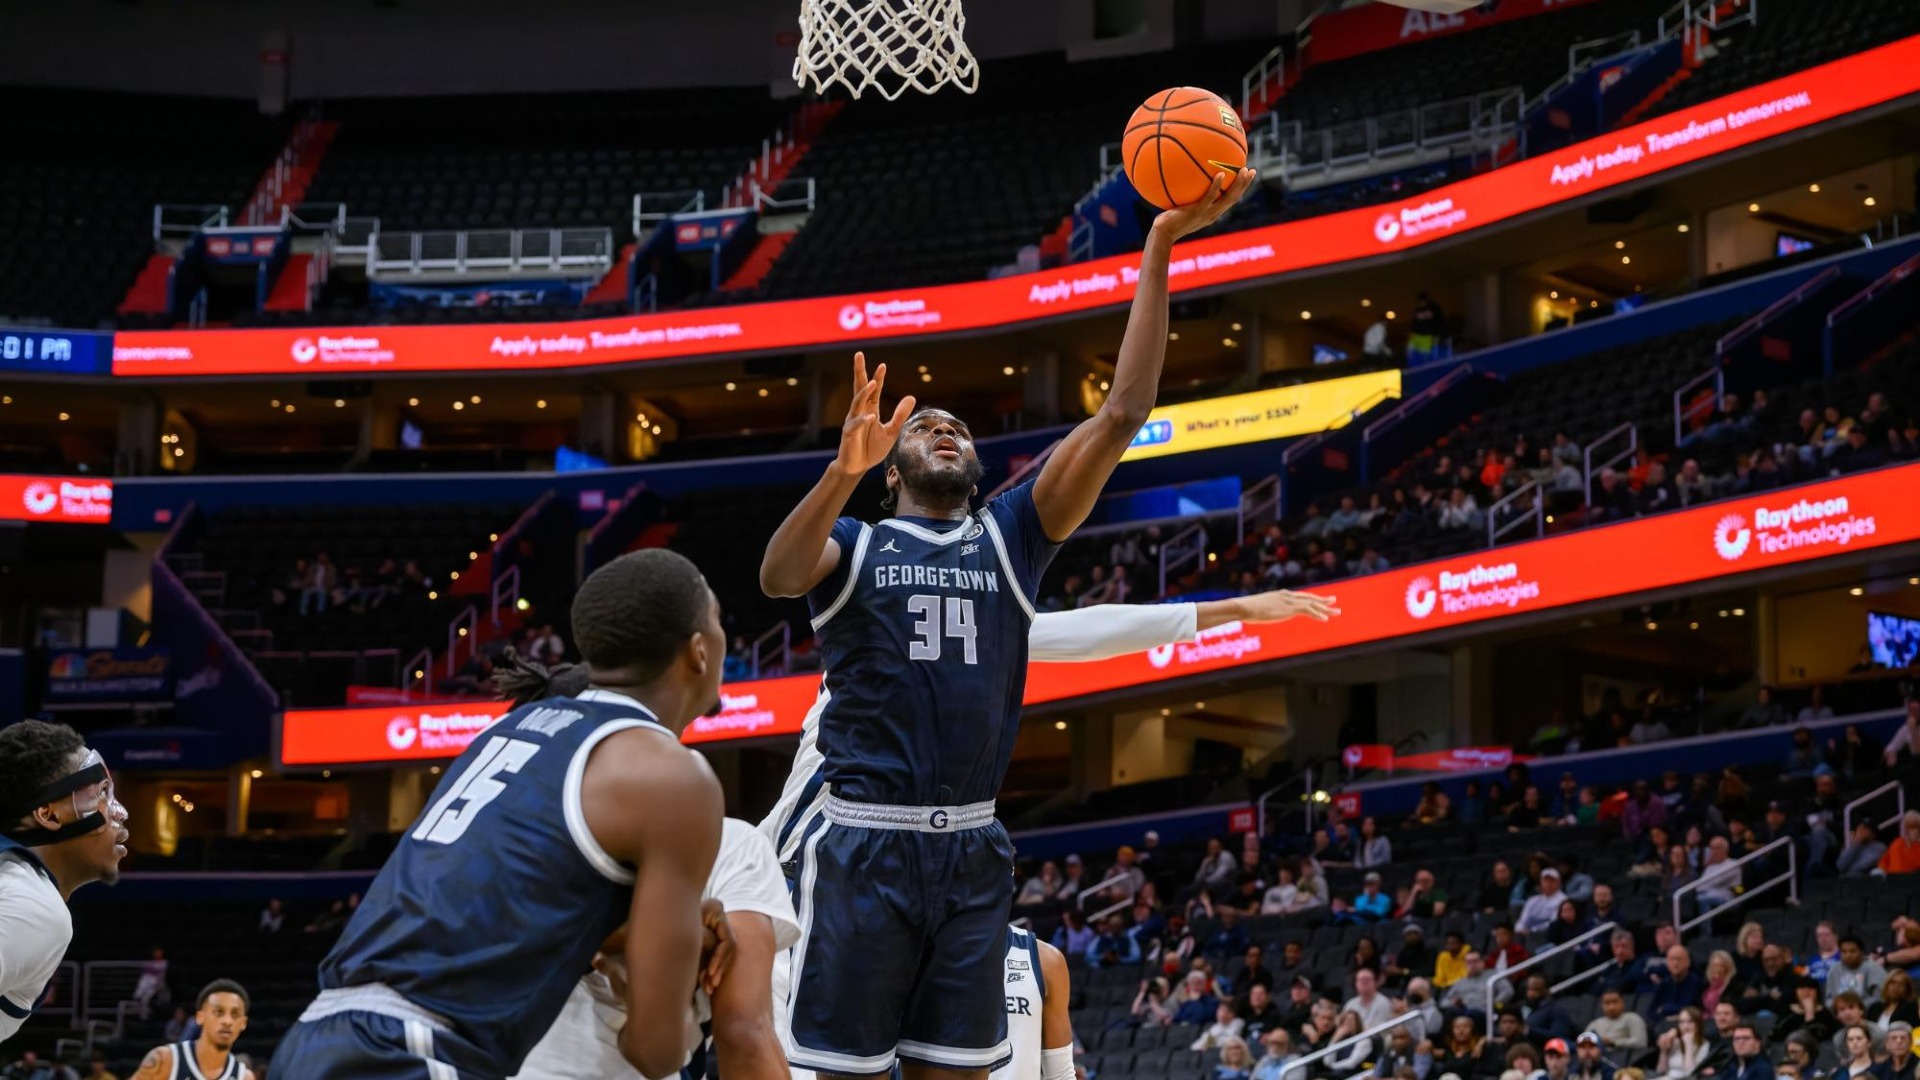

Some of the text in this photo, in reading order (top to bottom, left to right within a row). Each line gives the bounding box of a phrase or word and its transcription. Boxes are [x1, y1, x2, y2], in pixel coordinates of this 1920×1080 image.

[1551, 92, 1811, 185] Apply today. Transform tomorrow.
[1029, 280, 1072, 303] Apply
[41, 337, 72, 361] PM
[490, 336, 539, 356] Apply
[1233, 412, 1261, 426] your
[1754, 496, 1849, 531] Raytheon
[1755, 515, 1876, 554] Technologies
[875, 565, 998, 592] GEORGETOWN
[1439, 562, 1517, 593] Raytheon
[1441, 579, 1540, 613] Technologies
[908, 595, 977, 664] 34
[419, 712, 493, 733] Raytheon
[412, 736, 540, 845] 15
[929, 809, 949, 829] G
